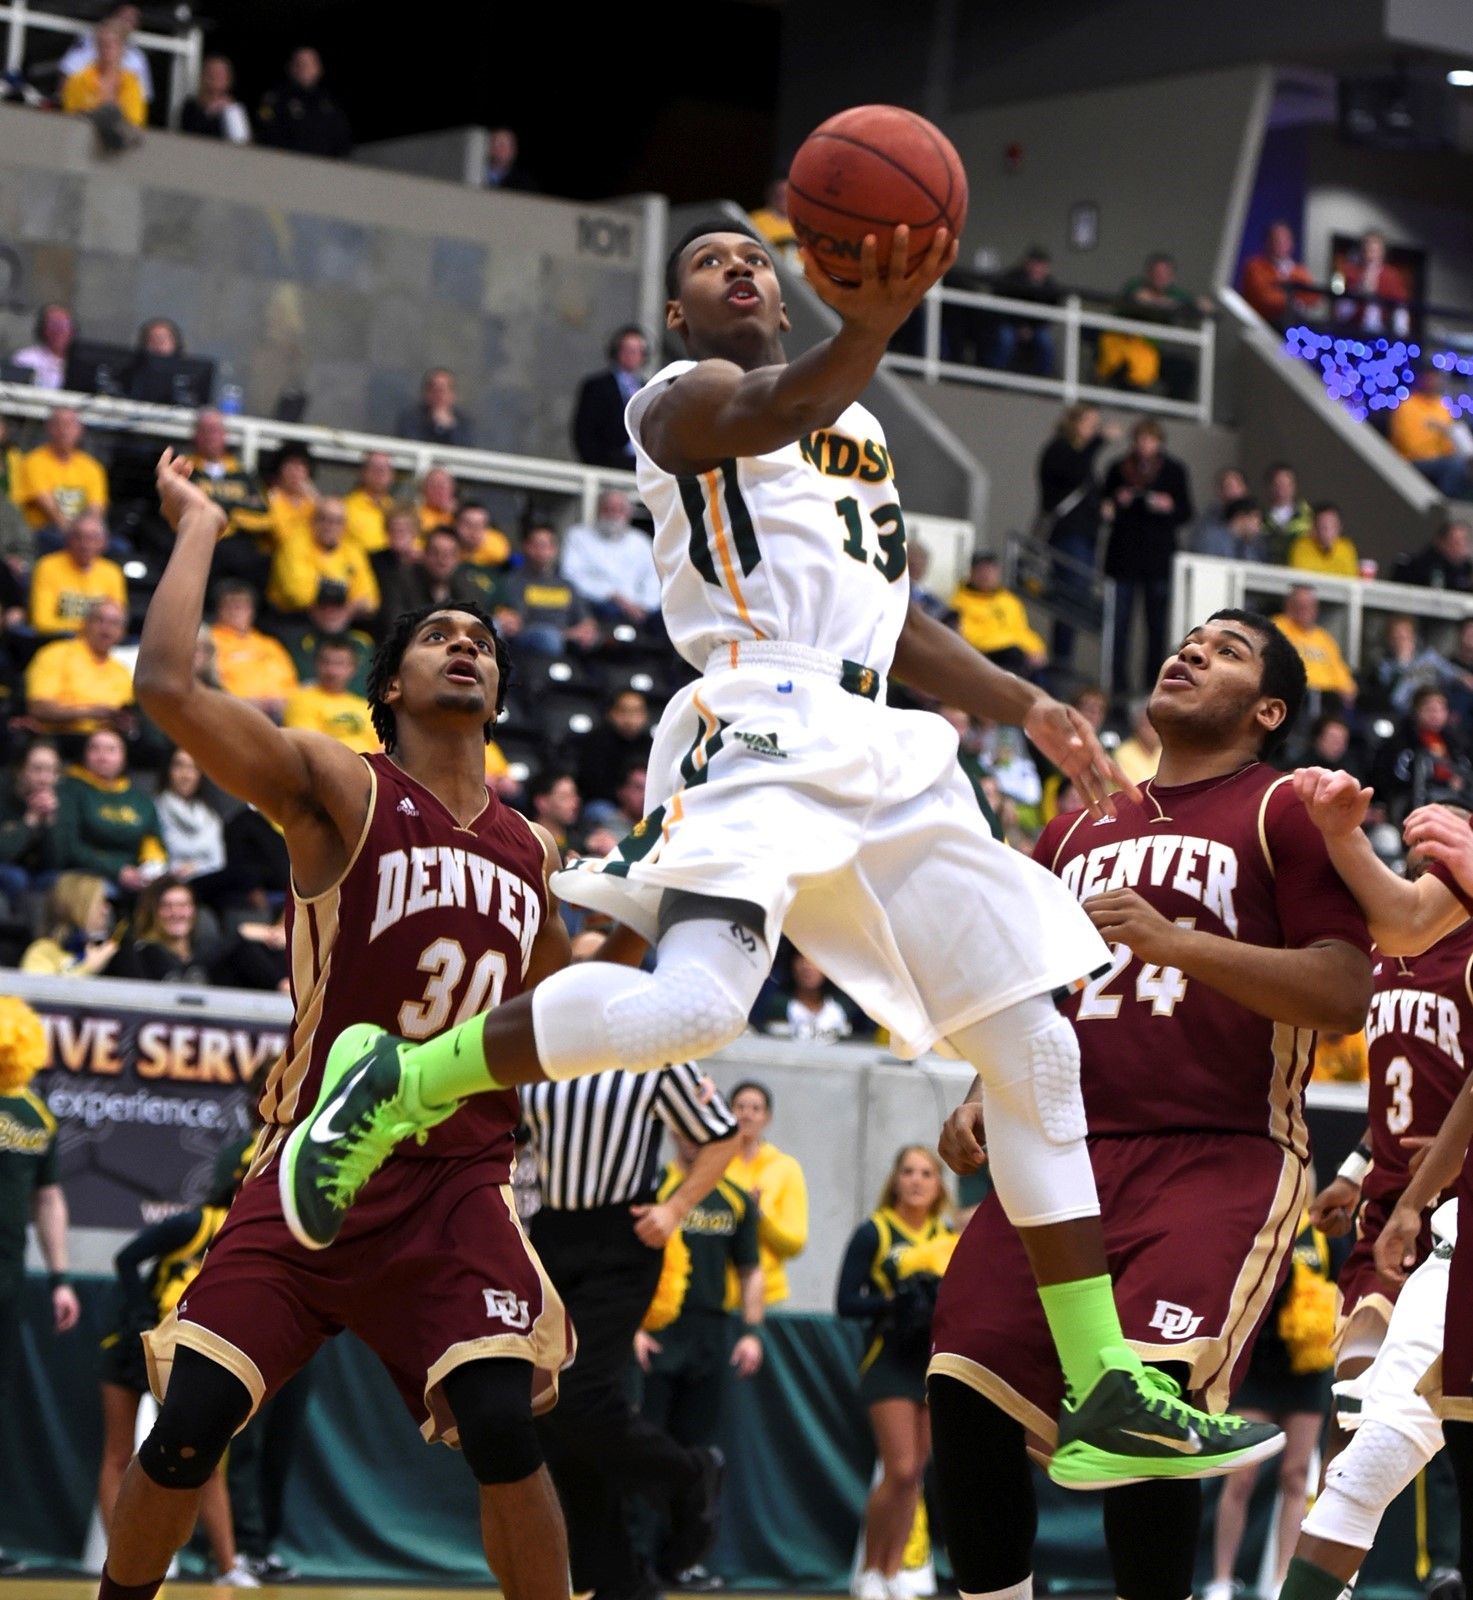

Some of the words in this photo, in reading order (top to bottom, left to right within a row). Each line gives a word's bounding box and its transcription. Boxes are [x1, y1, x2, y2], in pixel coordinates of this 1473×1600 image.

[834, 495, 907, 584] 13
[368, 846, 541, 983] DENVER
[1061, 834, 1239, 940] DENVER
[397, 936, 508, 1040] 30
[1076, 917, 1197, 1022] 24
[1385, 1055, 1414, 1136] 3
[1148, 1299, 1205, 1340] DU
